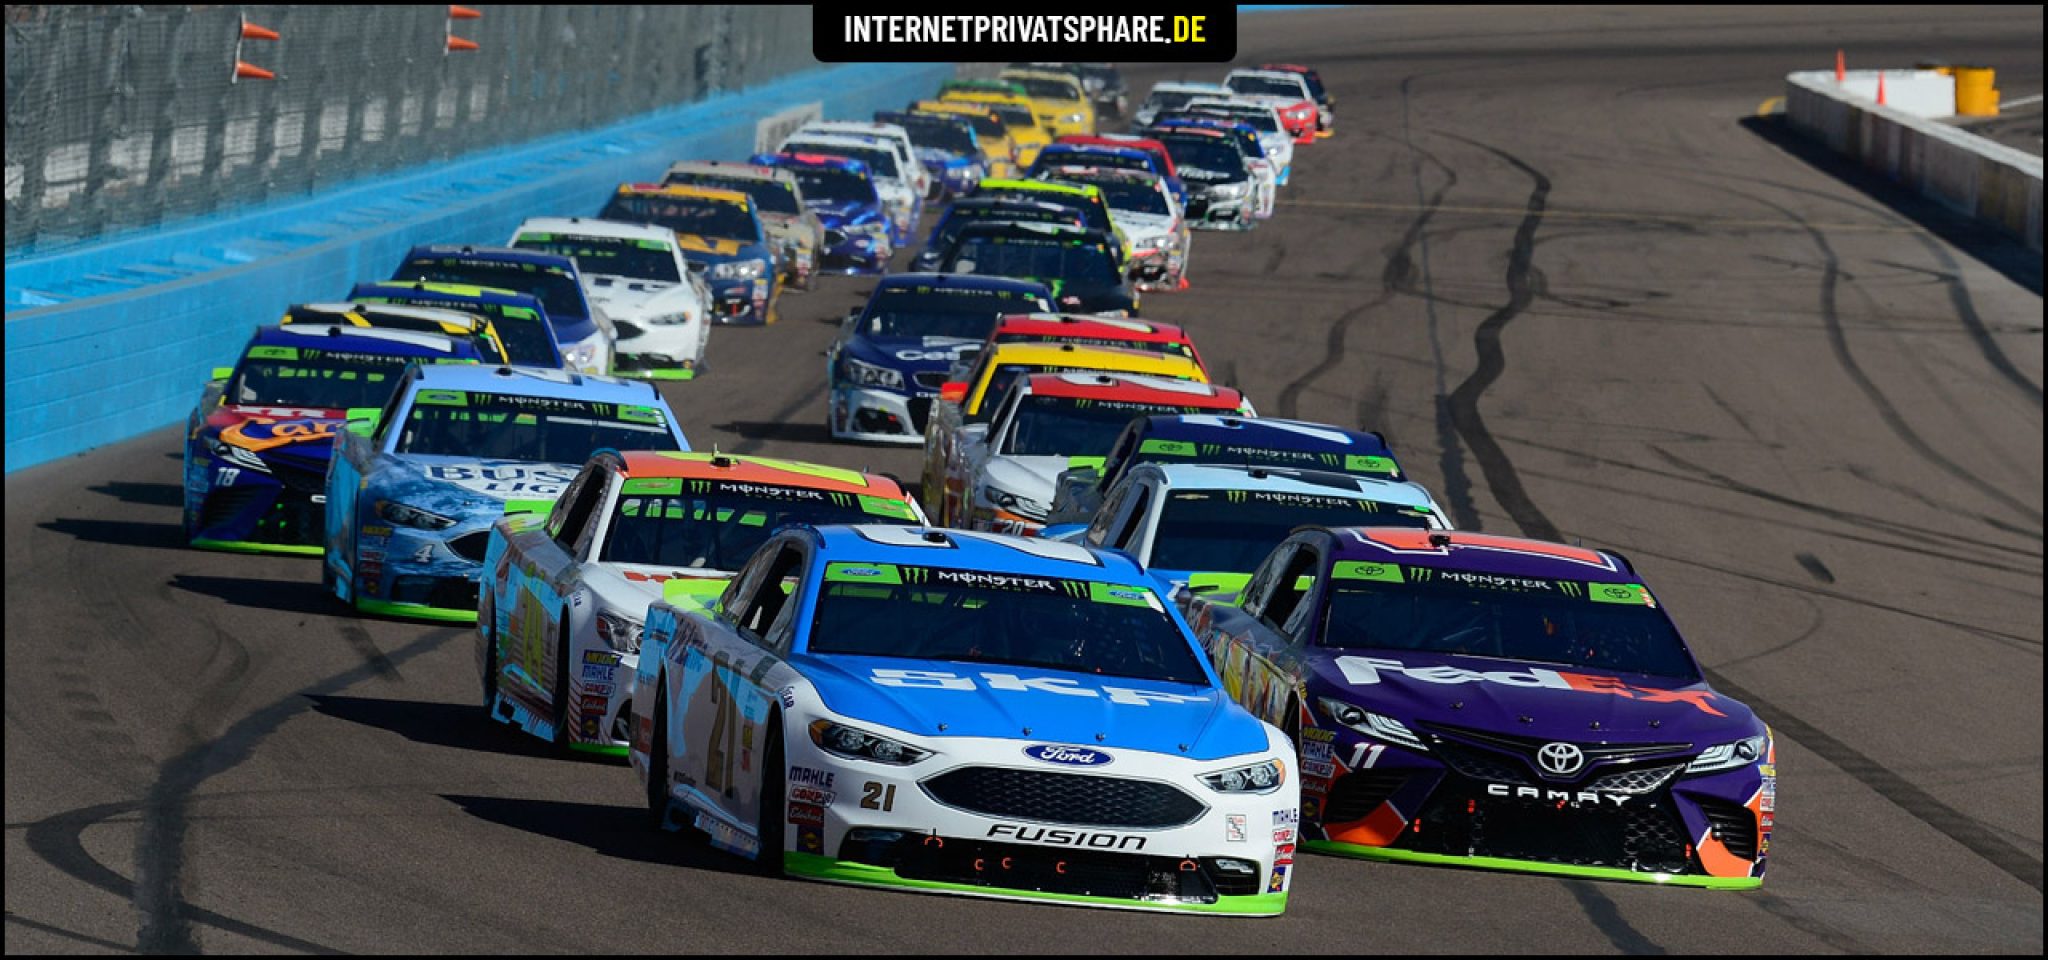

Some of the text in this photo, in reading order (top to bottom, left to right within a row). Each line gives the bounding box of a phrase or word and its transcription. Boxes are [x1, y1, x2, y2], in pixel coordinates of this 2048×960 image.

[499, 396, 585, 410] MONSTER
[1227, 446, 1315, 461] MONSTER
[216, 467, 240, 487] 18
[720, 484, 824, 500] MONSTER
[1255, 492, 1350, 508] MONSTER
[415, 543, 435, 563] 4
[938, 571, 1056, 591] MONSTER
[1441, 571, 1551, 590] MONSTER
[870, 668, 1210, 706] SKF
[1335, 655, 1728, 717] FedEx
[1041, 746, 1095, 765] Ford
[1349, 742, 1386, 769] 11
[789, 766, 834, 787] MAHLE
[860, 781, 896, 812] 21
[1487, 783, 1632, 807] CAMRY
[986, 823, 1148, 851] FUSION
